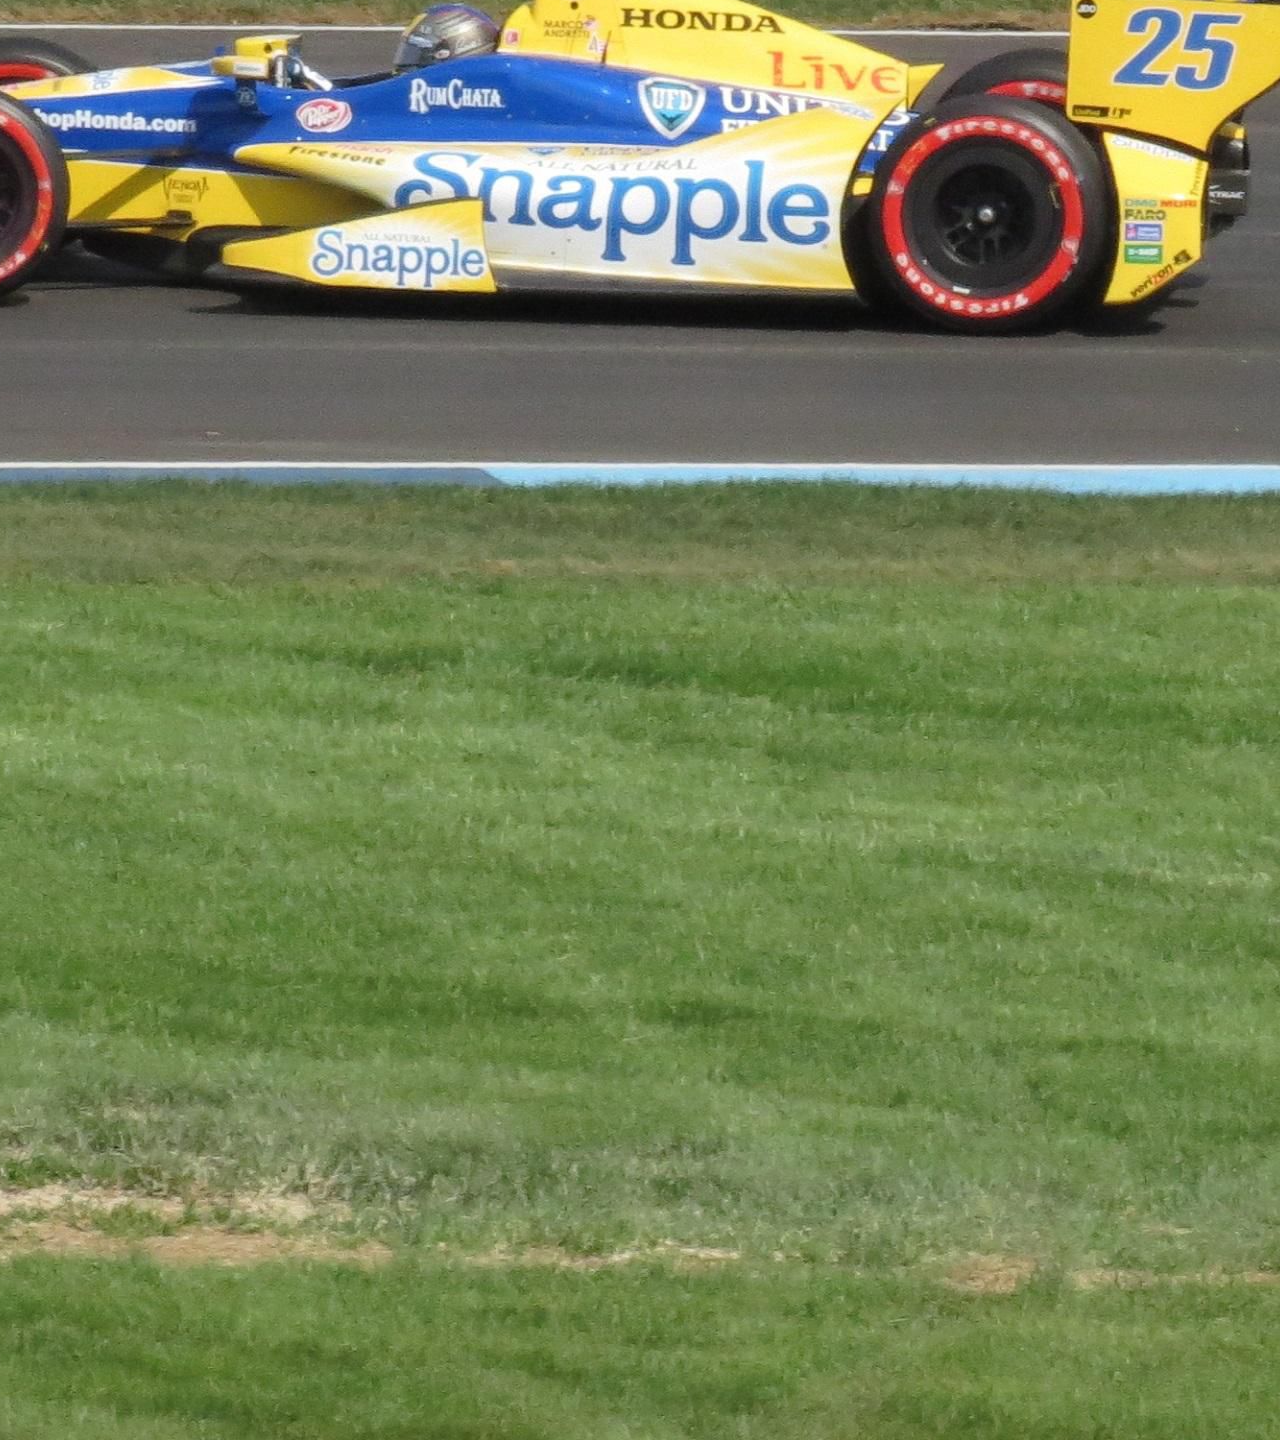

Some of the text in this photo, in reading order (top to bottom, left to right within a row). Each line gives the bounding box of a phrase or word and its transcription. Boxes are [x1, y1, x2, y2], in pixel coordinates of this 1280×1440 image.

[620, 7, 786, 34] HONDA
[1113, 7, 1244, 91] 25
[650, 88, 693, 111] UFD
[288, 145, 386, 166] Firestone
[935, 120, 1071, 180] Firestone
[580, 158, 698, 172] NATURAL
[394, 151, 830, 265] Snapple
[1124, 208, 1167, 221] FARO
[384, 232, 433, 243] NATURAL
[312, 230, 485, 288] Snapple
[1131, 264, 1175, 299] verizon
